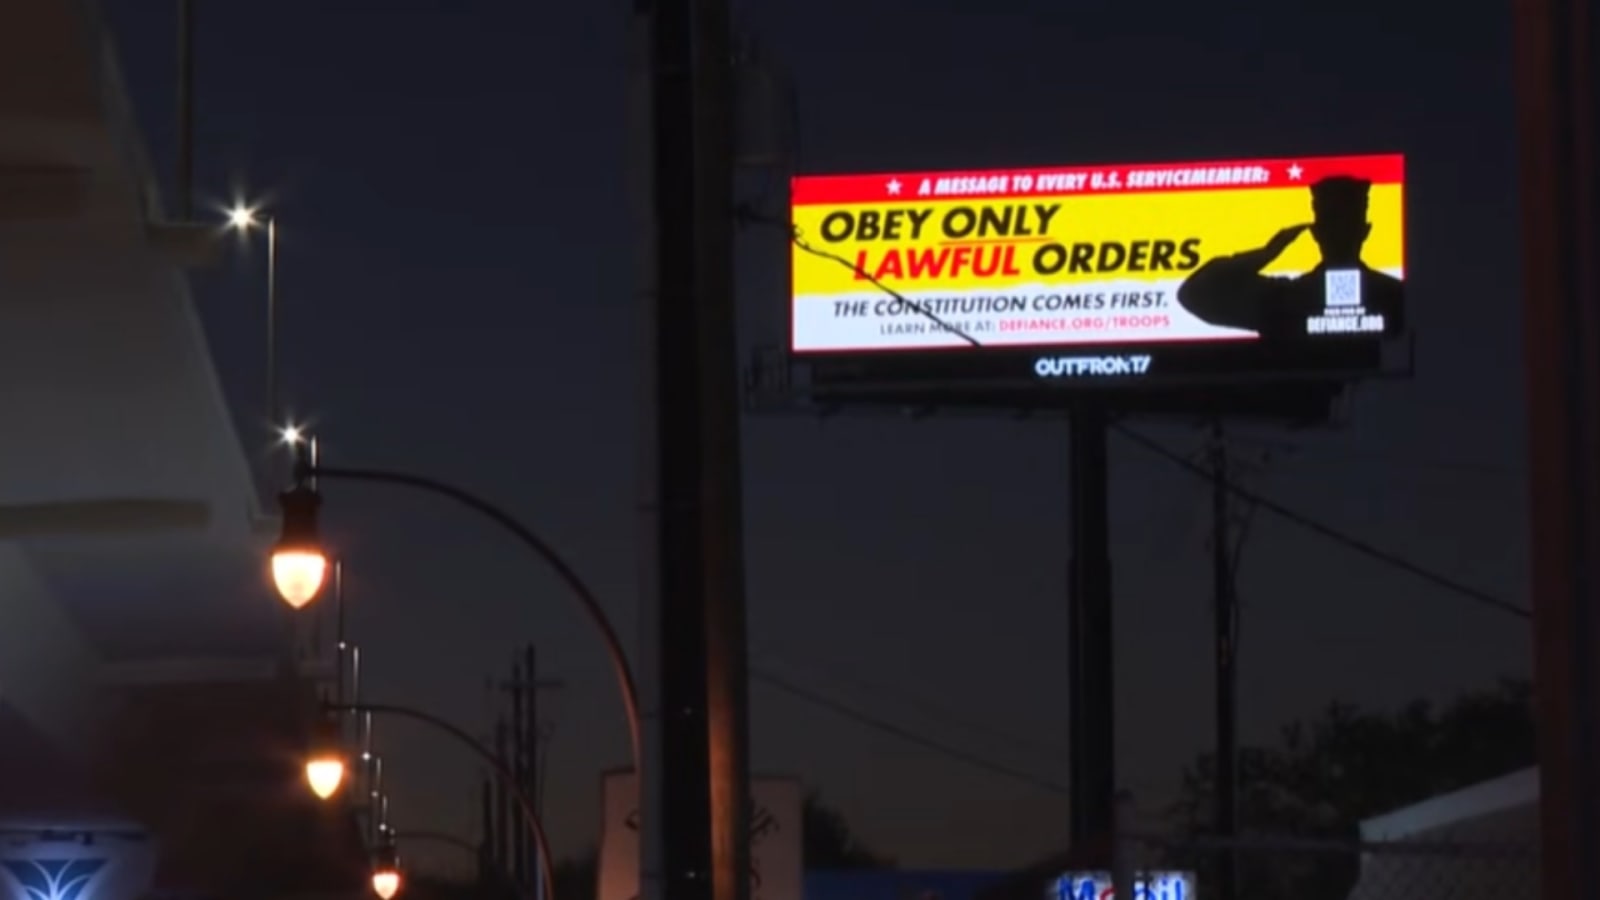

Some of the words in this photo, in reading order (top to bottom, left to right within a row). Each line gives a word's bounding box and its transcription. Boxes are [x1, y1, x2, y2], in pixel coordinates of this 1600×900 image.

[918, 179, 931, 196] A
[934, 176, 1008, 195] MESSAGE
[1013, 175, 1033, 191] TO
[1036, 173, 1087, 190] EVERY
[1090, 172, 1122, 188] U.S.
[1126, 166, 1270, 188] SERVICEMEMBER:
[820, 209, 934, 243] OBEY
[942, 204, 1061, 239] ONLY
[854, 244, 1020, 281] LAWFUL
[1032, 237, 1201, 276] ORDERS
[833, 301, 869, 317] THE
[874, 294, 1027, 316] CONSTITUTION
[1032, 292, 1105, 310] COMES
[1110, 290, 1168, 309] FIRST.
[879, 322, 925, 336] LEARN
[928, 319, 970, 334] MORE
[999, 314, 1170, 332] DEFIANCE.ORG/TROOPS
